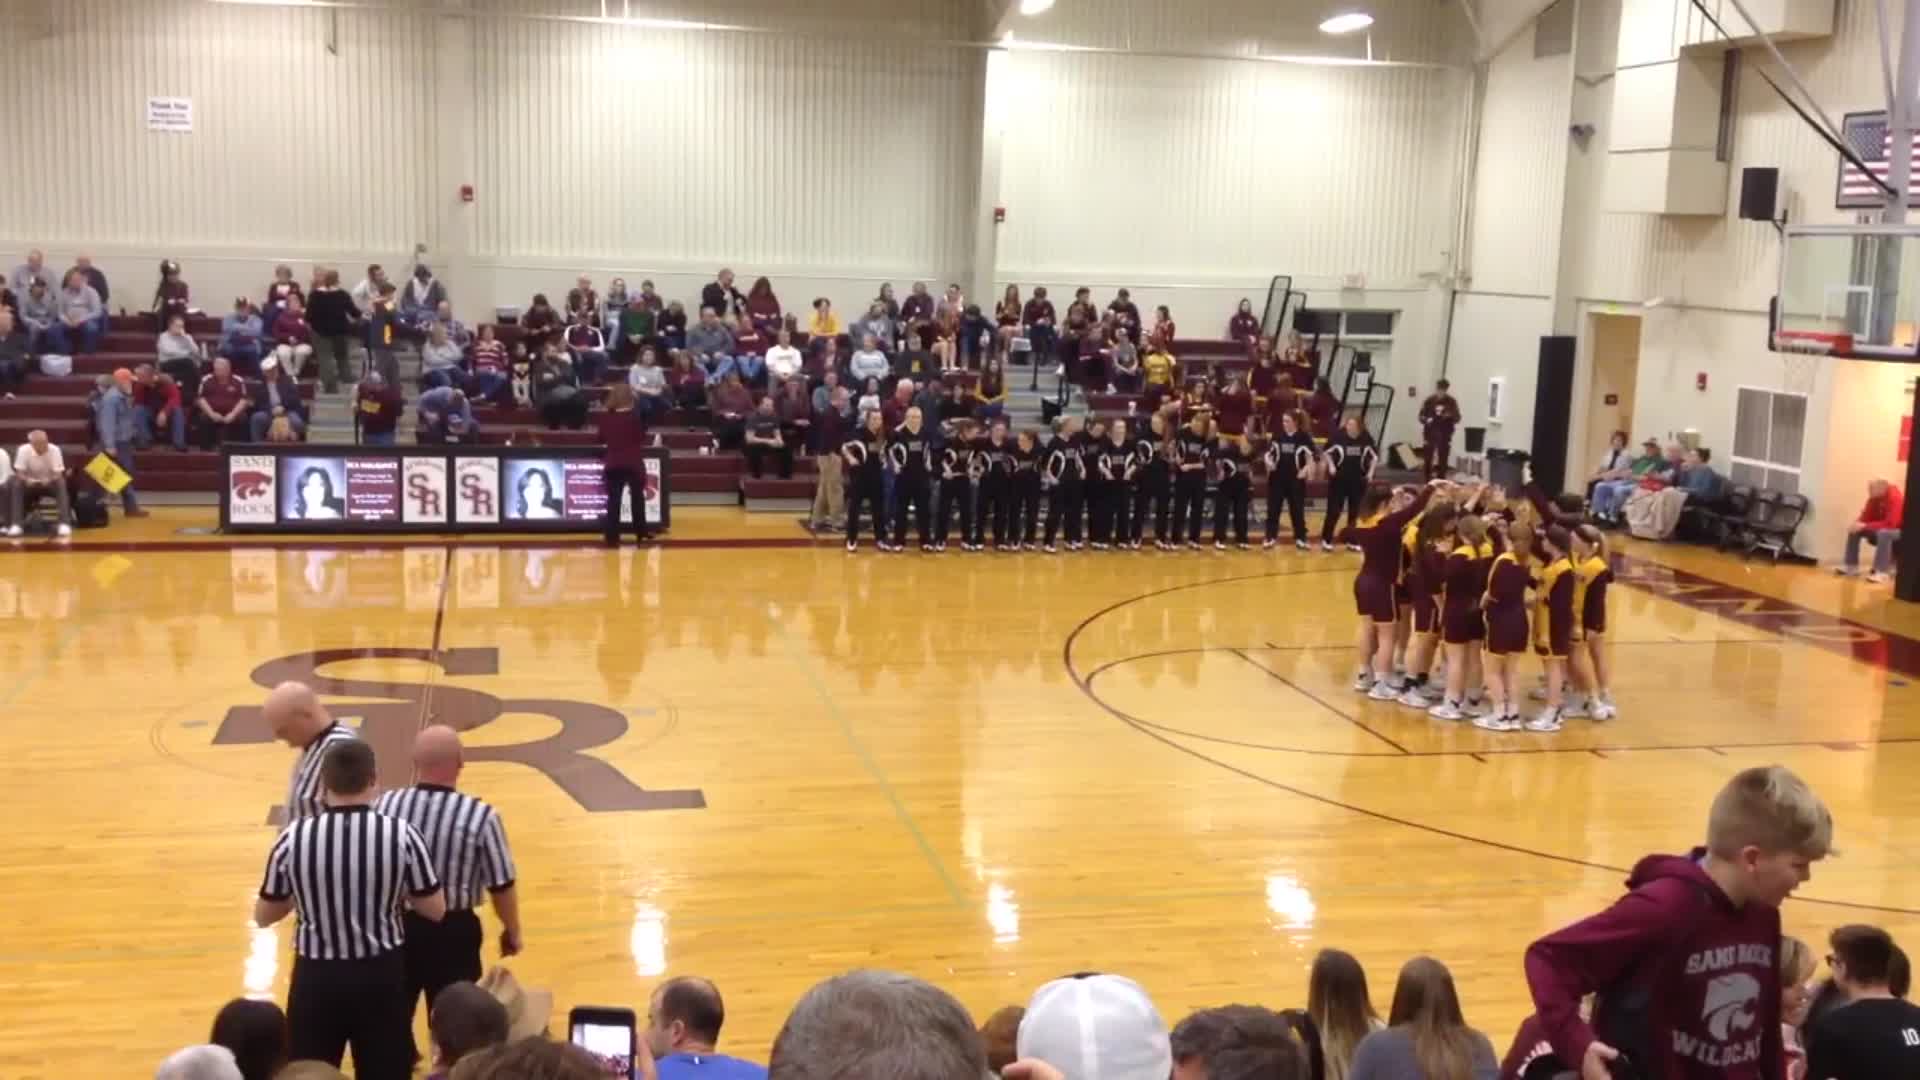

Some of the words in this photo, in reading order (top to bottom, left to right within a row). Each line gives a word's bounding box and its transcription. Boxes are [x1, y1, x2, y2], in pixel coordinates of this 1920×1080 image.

[232, 456, 273, 467] SAND
[232, 503, 273, 515] ROCK
[1684, 946, 1736, 974] SAND
[1671, 1027, 1763, 1067] WILDCA
